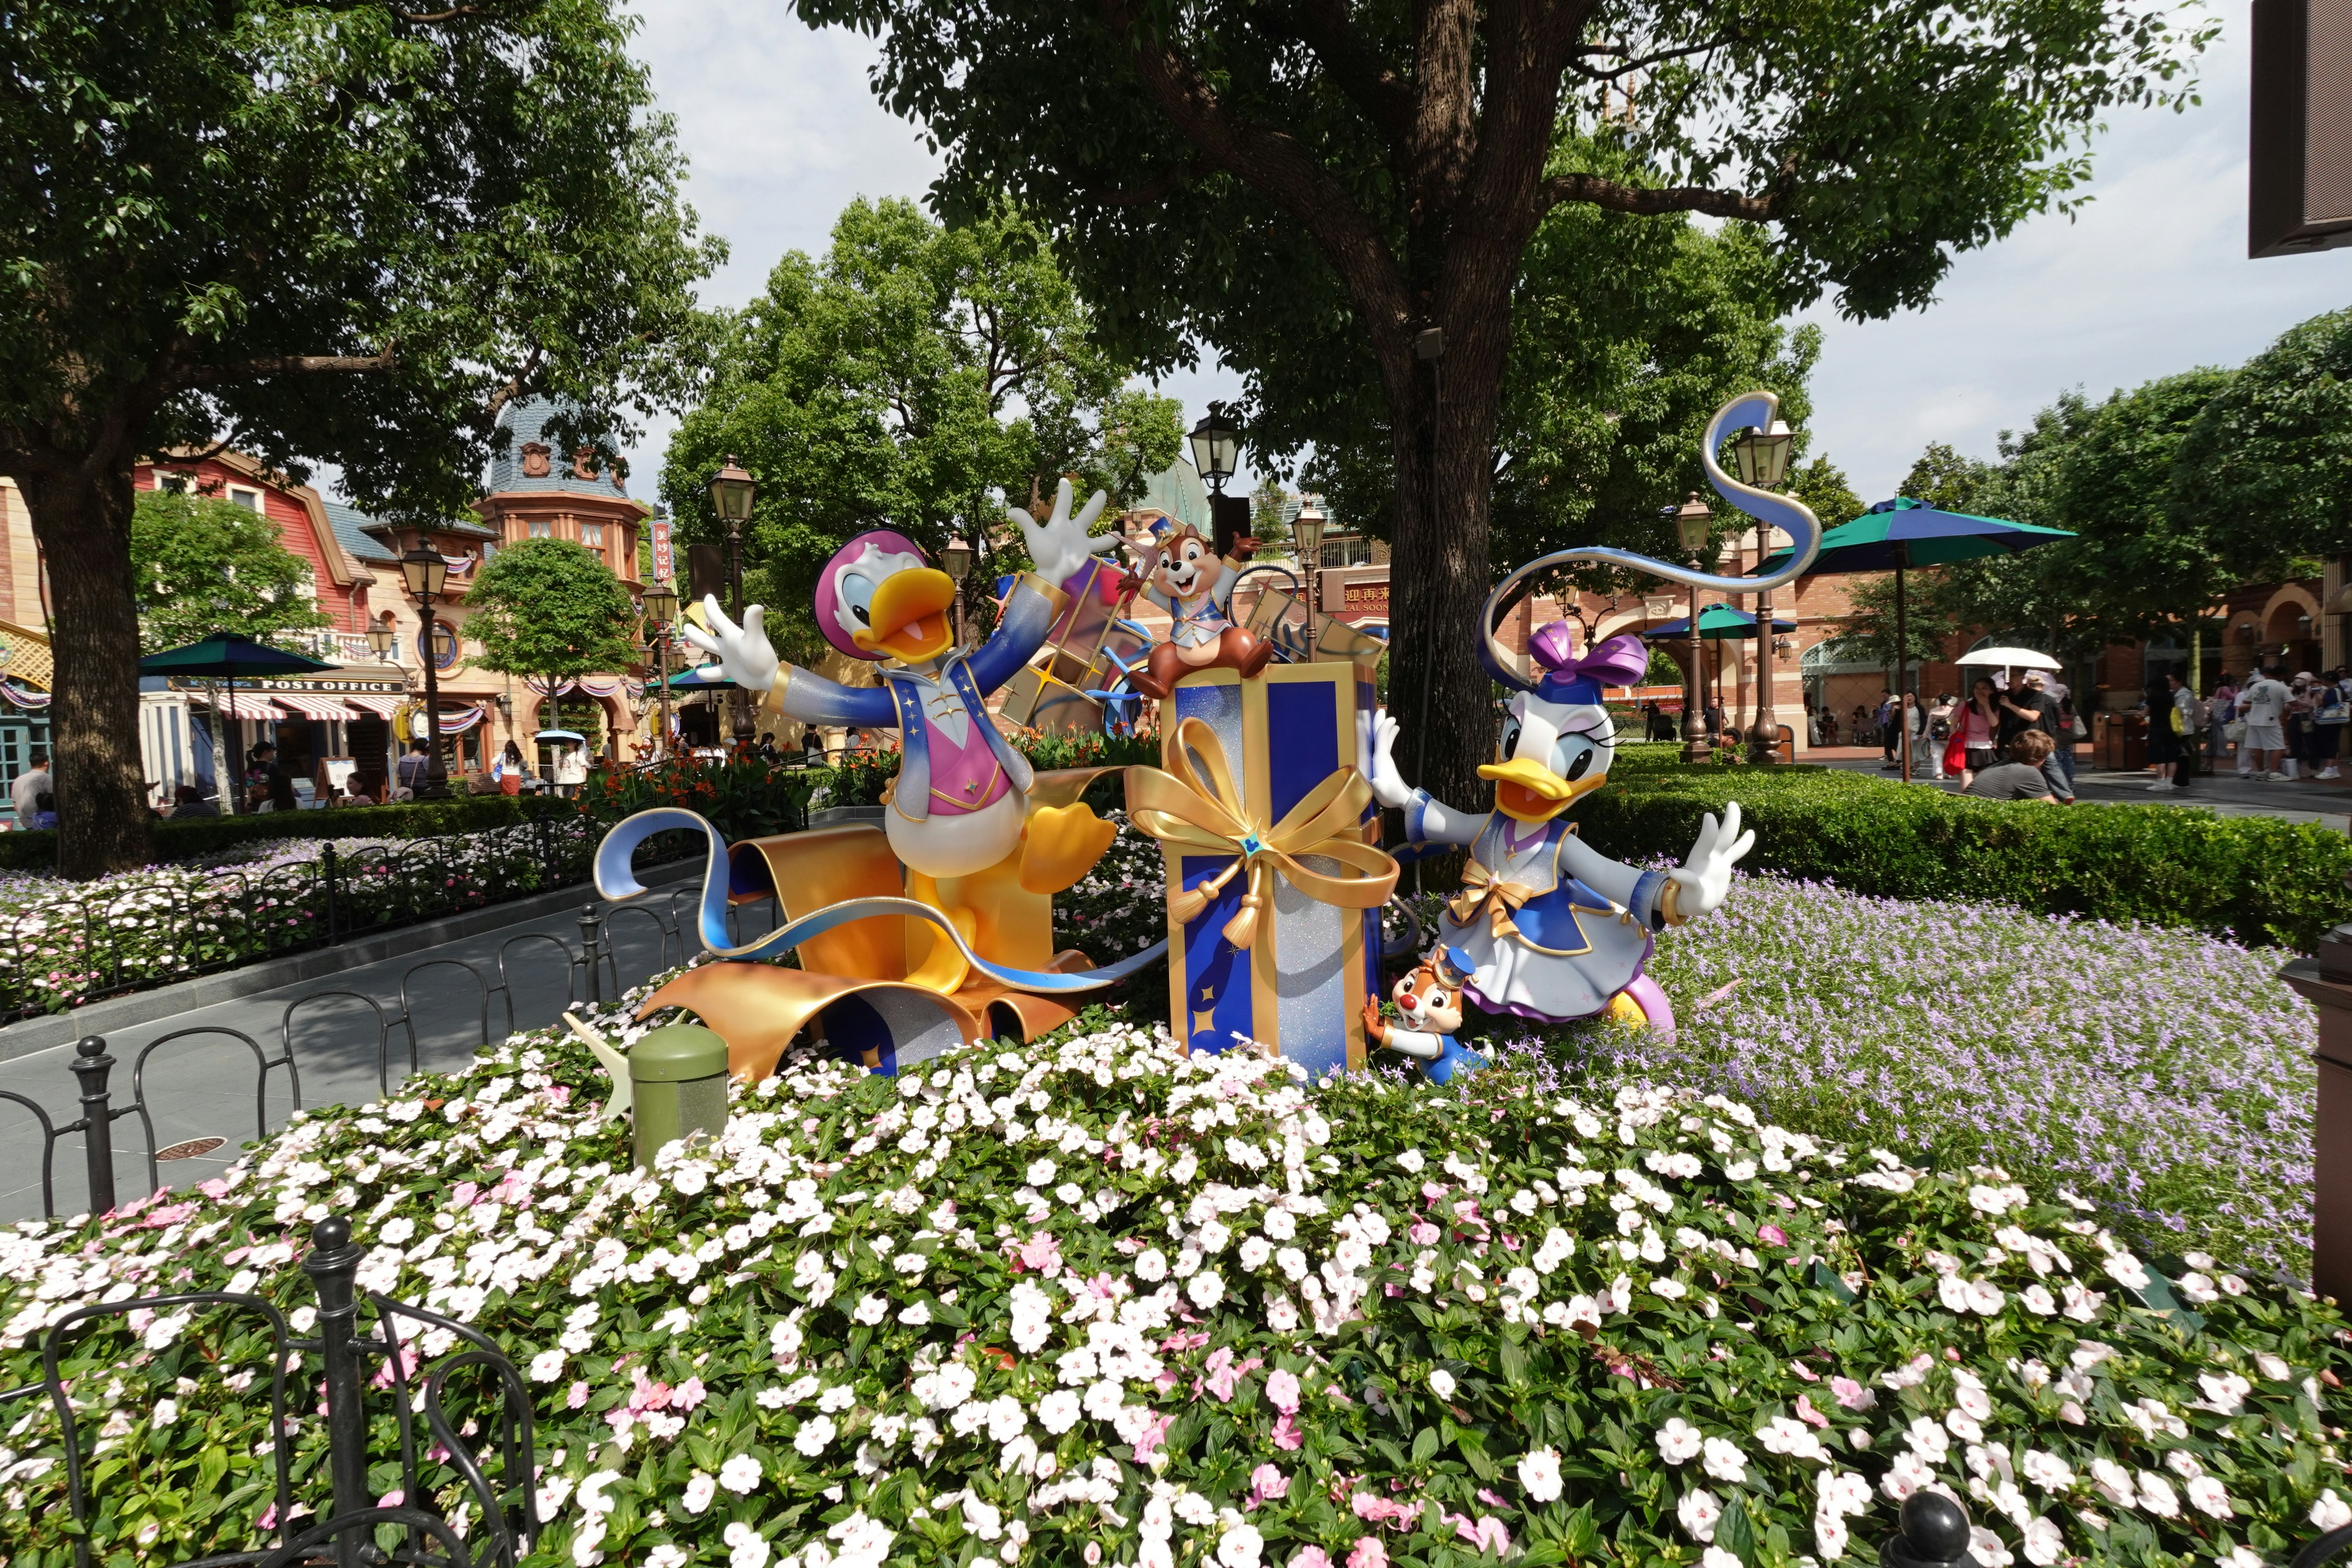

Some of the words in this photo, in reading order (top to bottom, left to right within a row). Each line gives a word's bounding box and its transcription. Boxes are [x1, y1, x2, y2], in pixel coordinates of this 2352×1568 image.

[1345, 587, 1390, 602] 迎再来
[261, 680, 315, 690] POST
[322, 682, 392, 691] OFFICE
